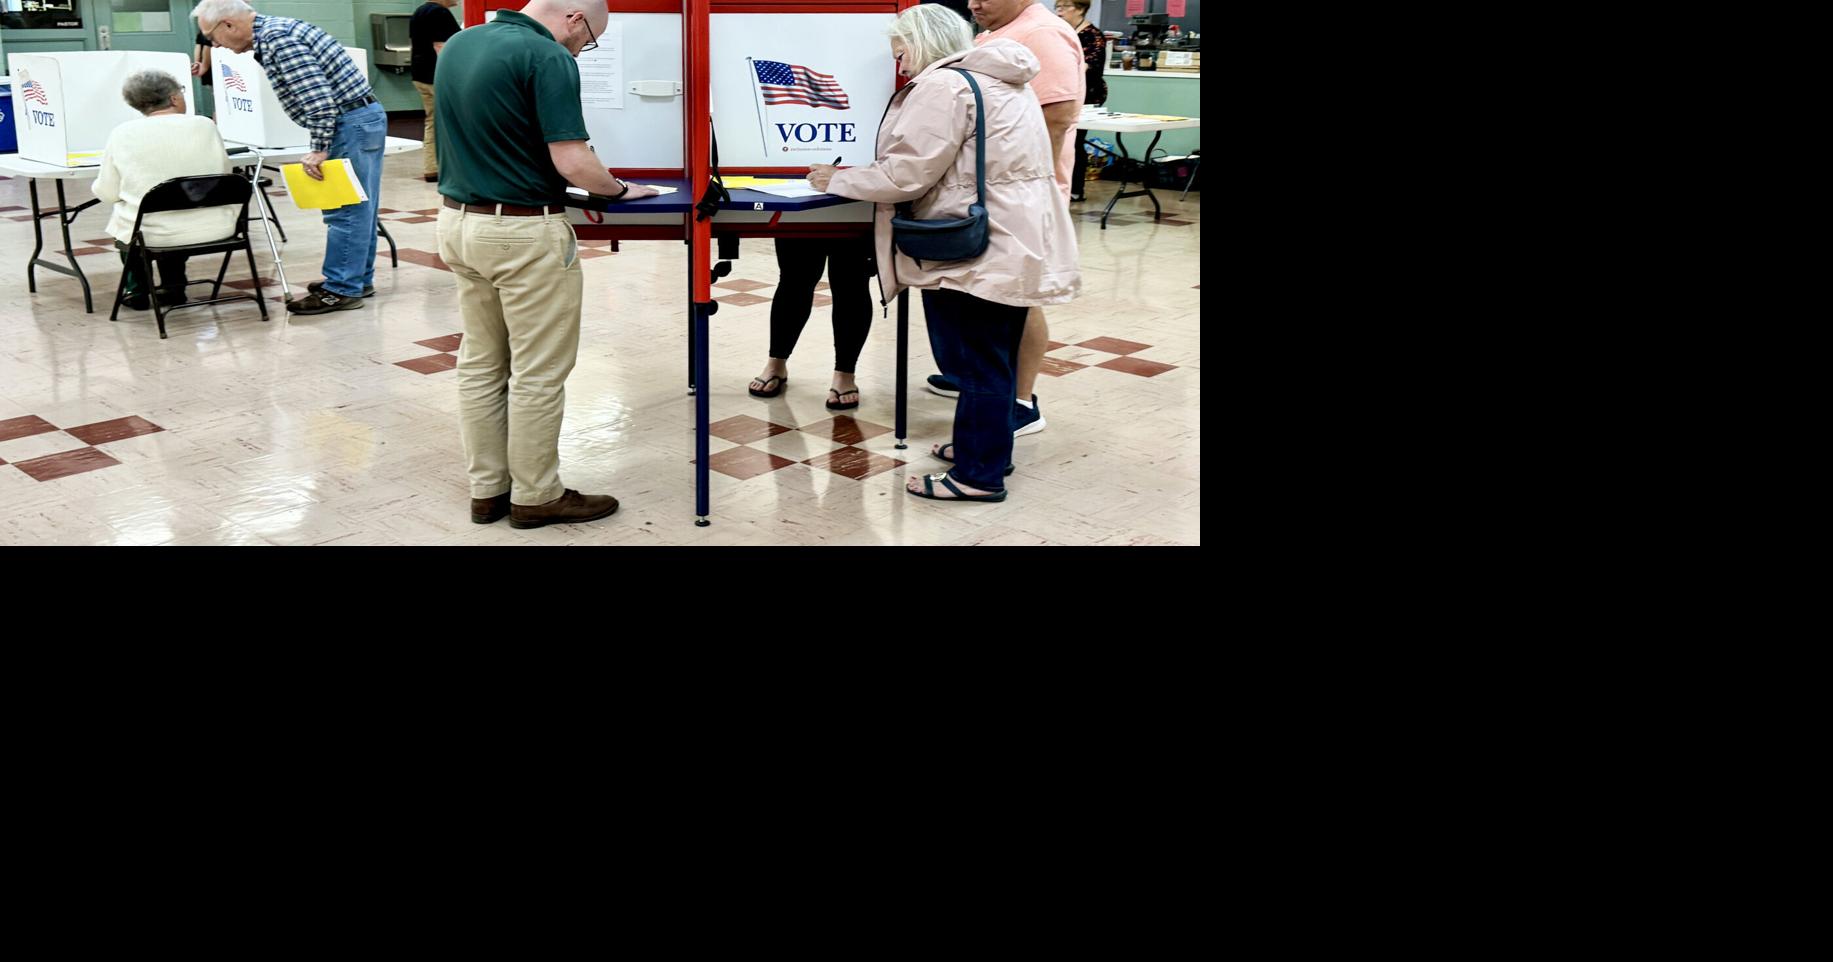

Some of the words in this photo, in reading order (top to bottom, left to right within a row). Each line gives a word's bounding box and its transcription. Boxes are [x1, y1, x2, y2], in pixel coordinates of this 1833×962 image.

[232, 97, 253, 113] VOTE
[32, 110, 55, 127] VOTE
[774, 123, 857, 143] VOTE
